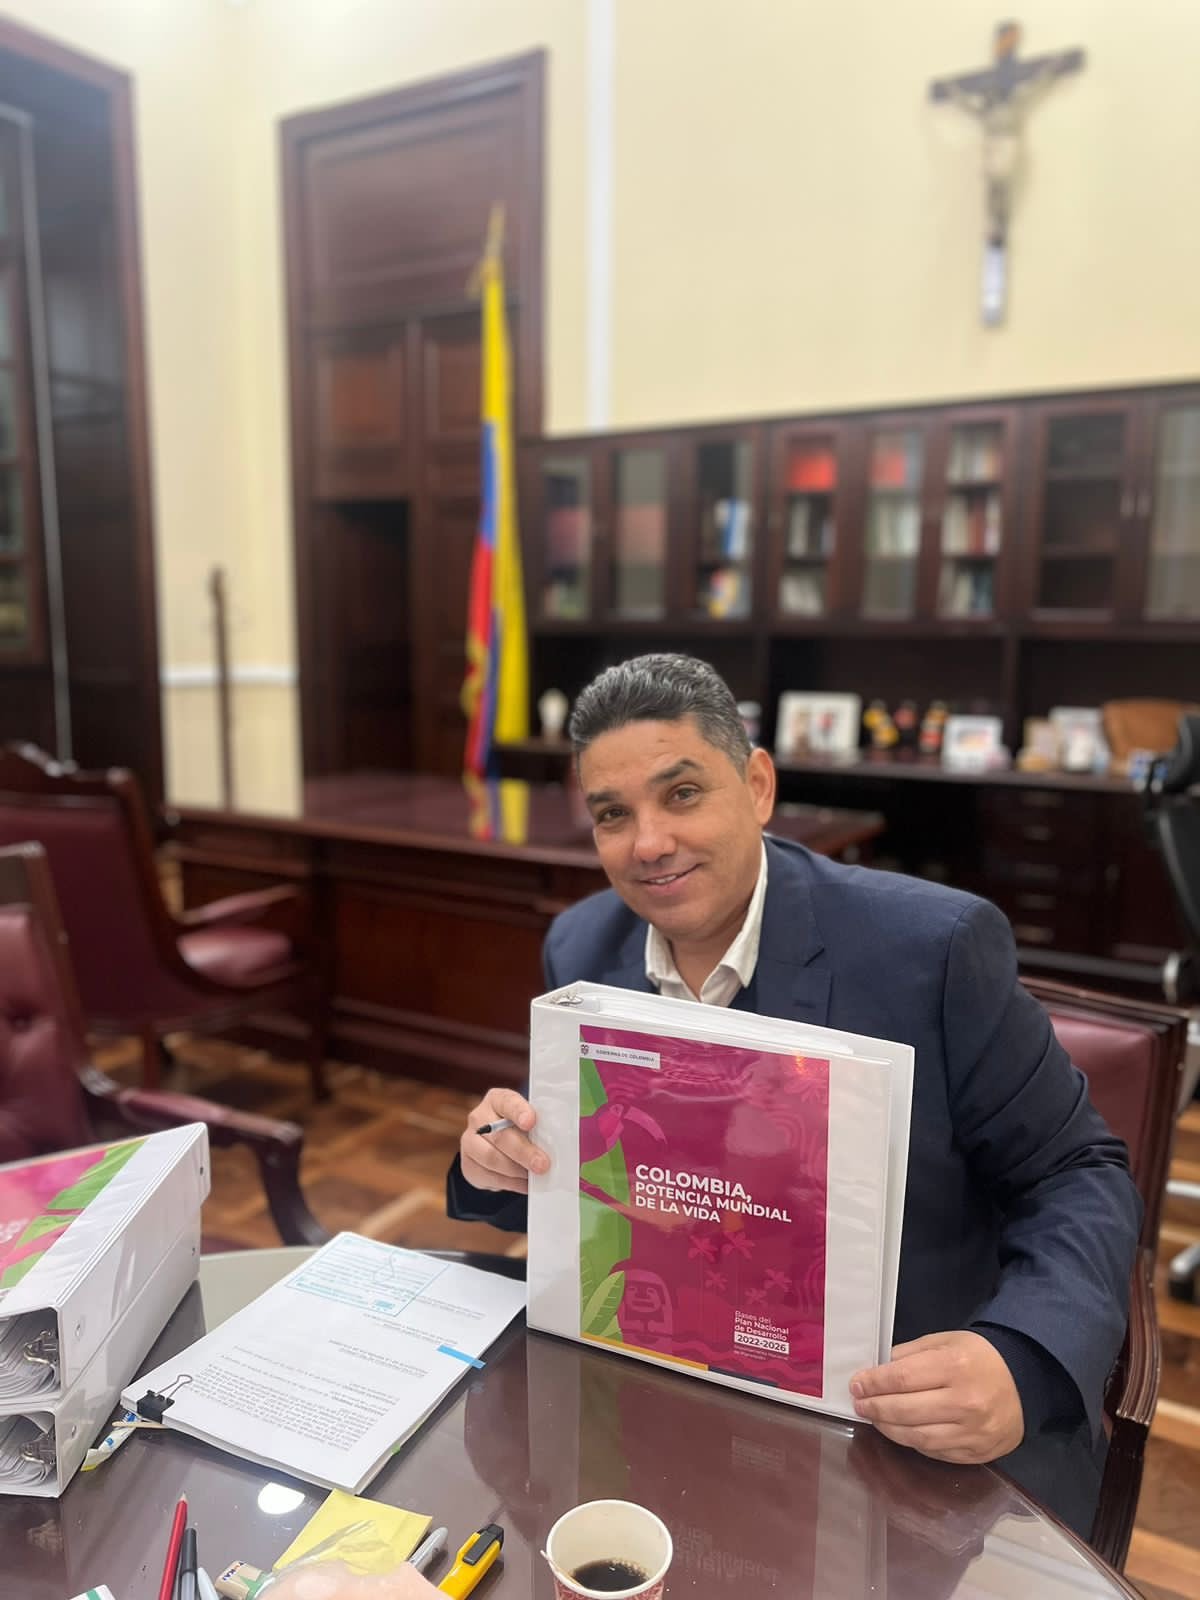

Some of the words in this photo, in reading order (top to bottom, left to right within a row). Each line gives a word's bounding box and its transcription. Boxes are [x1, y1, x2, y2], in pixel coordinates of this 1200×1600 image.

[635, 1164, 752, 1202] COLOMBIA,
[635, 1182, 713, 1208] POTENCIA
[716, 1199, 792, 1223] MUNDIAL
[635, 1195, 656, 1210] DE
[660, 1200, 680, 1215] LA
[682, 1204, 721, 1223] VIDA
[735, 1317, 753, 1327] Plan
[754, 1322, 789, 1335] Nacional
[759, 1316, 771, 1324] del
[734, 1325, 745, 1333] de
[746, 1327, 787, 1341] Desarrollo
[736, 1334, 787, 1352] 2022-2026
